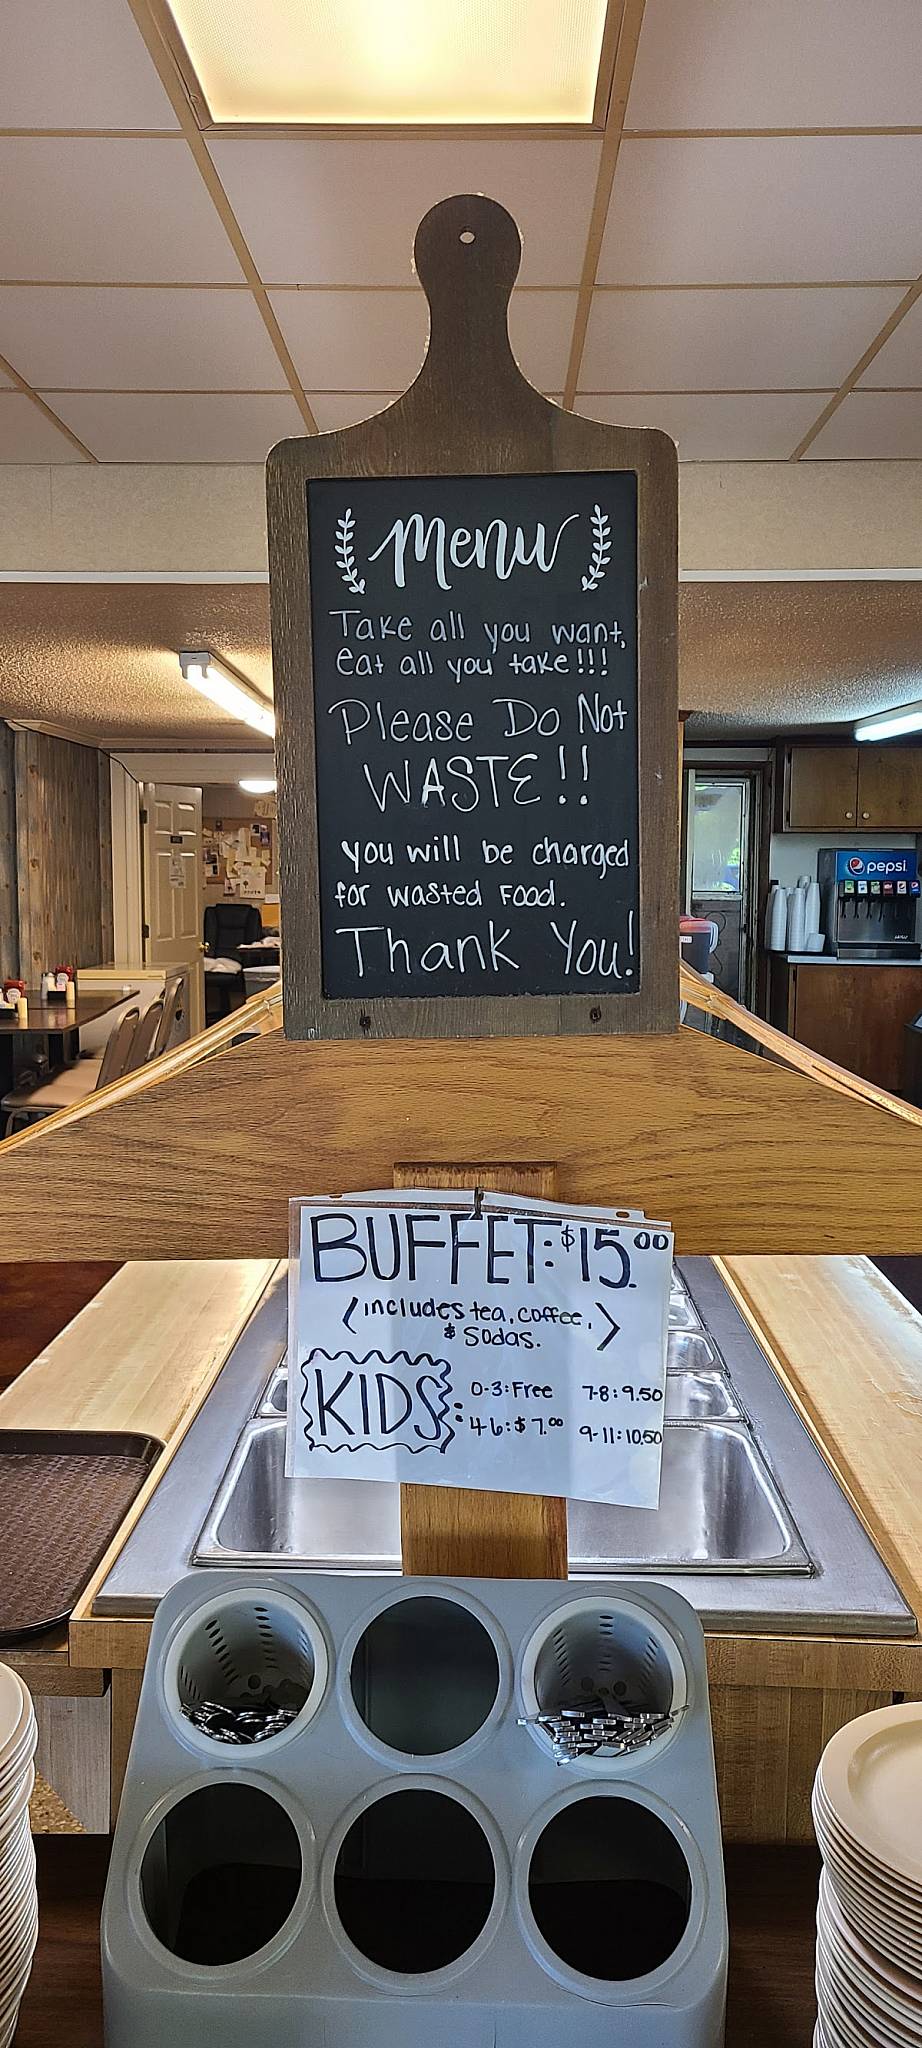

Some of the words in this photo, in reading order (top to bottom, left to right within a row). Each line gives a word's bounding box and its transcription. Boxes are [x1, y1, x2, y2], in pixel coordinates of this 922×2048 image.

[367, 513, 580, 590] Menu
[329, 609, 413, 641] Take
[429, 610, 465, 642] all
[484, 620, 531, 653] you
[552, 620, 627, 649] want,
[400, 650, 433, 675] all
[447, 656, 494, 684] you
[508, 648, 609, 677] take!!!
[328, 698, 475, 745] Please
[492, 698, 561, 737] Do
[577, 692, 628, 734] Not
[363, 744, 589, 813] WASTE!!
[341, 840, 394, 874] you
[406, 834, 461, 863] will
[482, 839, 513, 864] be
[532, 836, 630, 880] charged
[867, 859, 908, 875] pepsi
[334, 880, 371, 909] for
[386, 880, 483, 908] wasted
[335, 920, 520, 977] Thank
[550, 909, 635, 979] You!
[309, 1212, 562, 1286] BUFFET:
[469, 1301, 515, 1325] tea,
